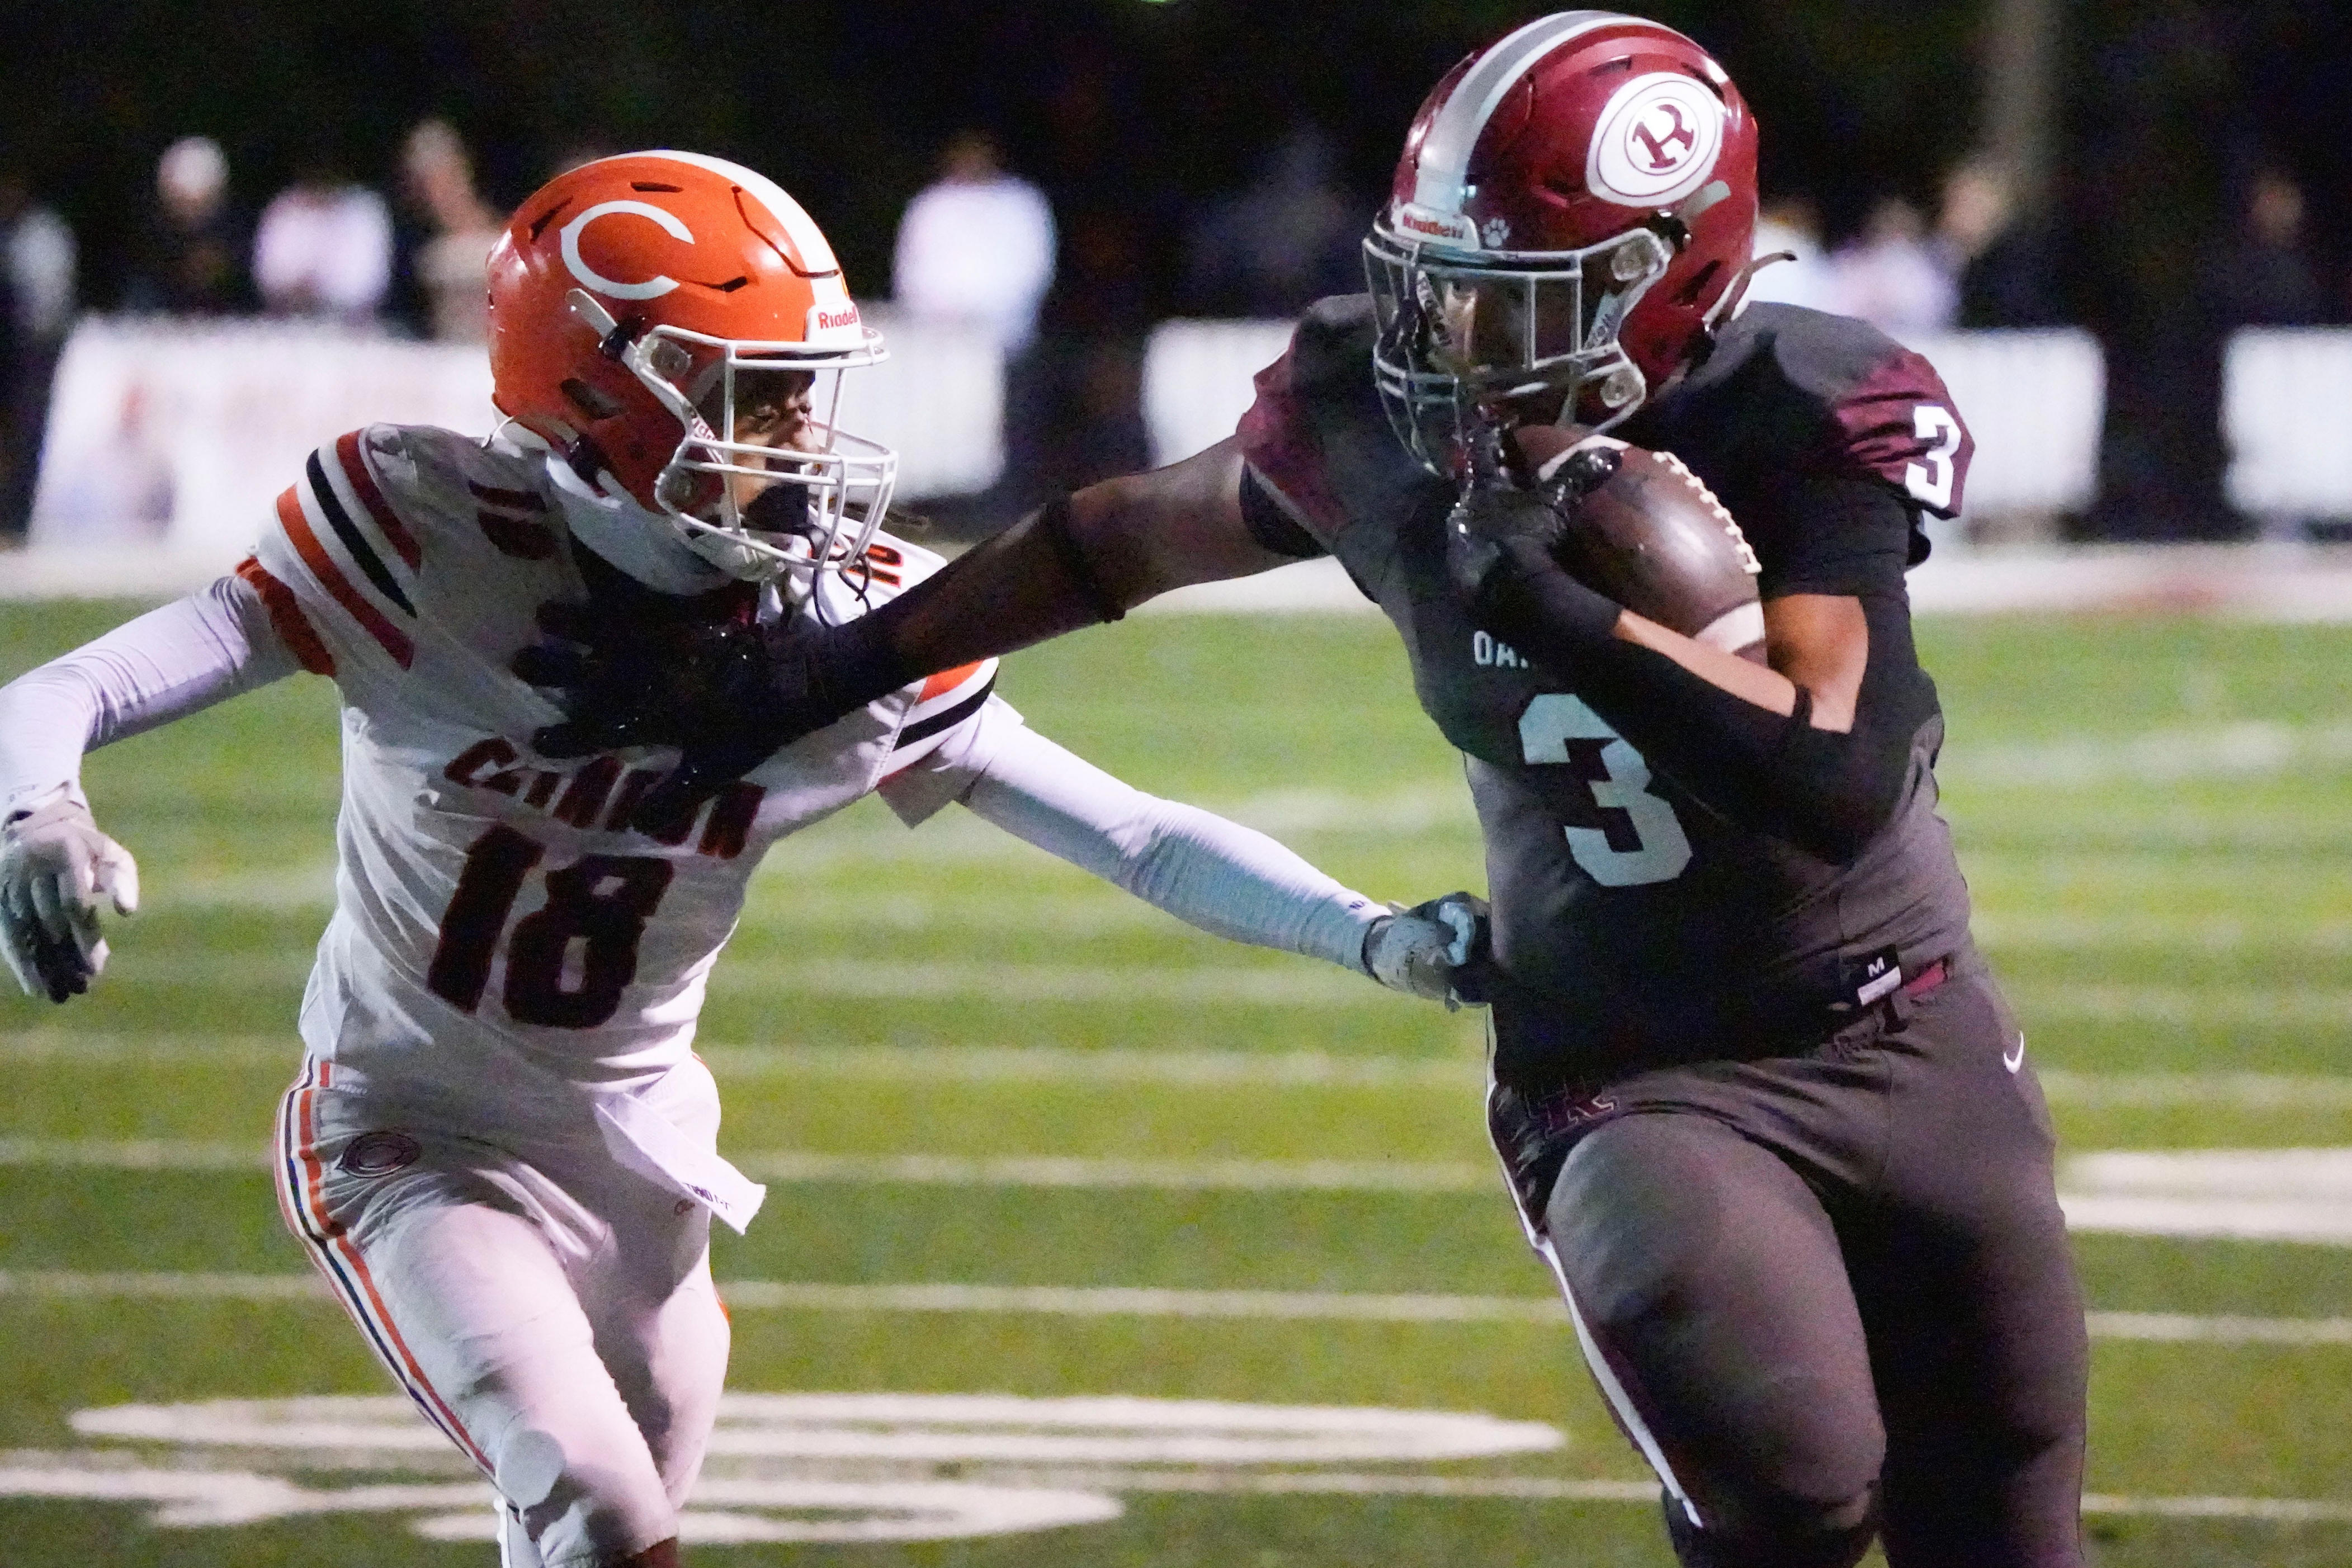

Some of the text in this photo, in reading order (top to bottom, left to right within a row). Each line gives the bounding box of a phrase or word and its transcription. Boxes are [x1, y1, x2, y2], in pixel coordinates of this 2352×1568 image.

[1632, 104, 1694, 168] R
[560, 199, 695, 300] C
[1904, 405, 1962, 509] 3
[1518, 692, 1693, 887] 3
[426, 822, 674, 1029] 18
[1868, 957, 1885, 977] M
